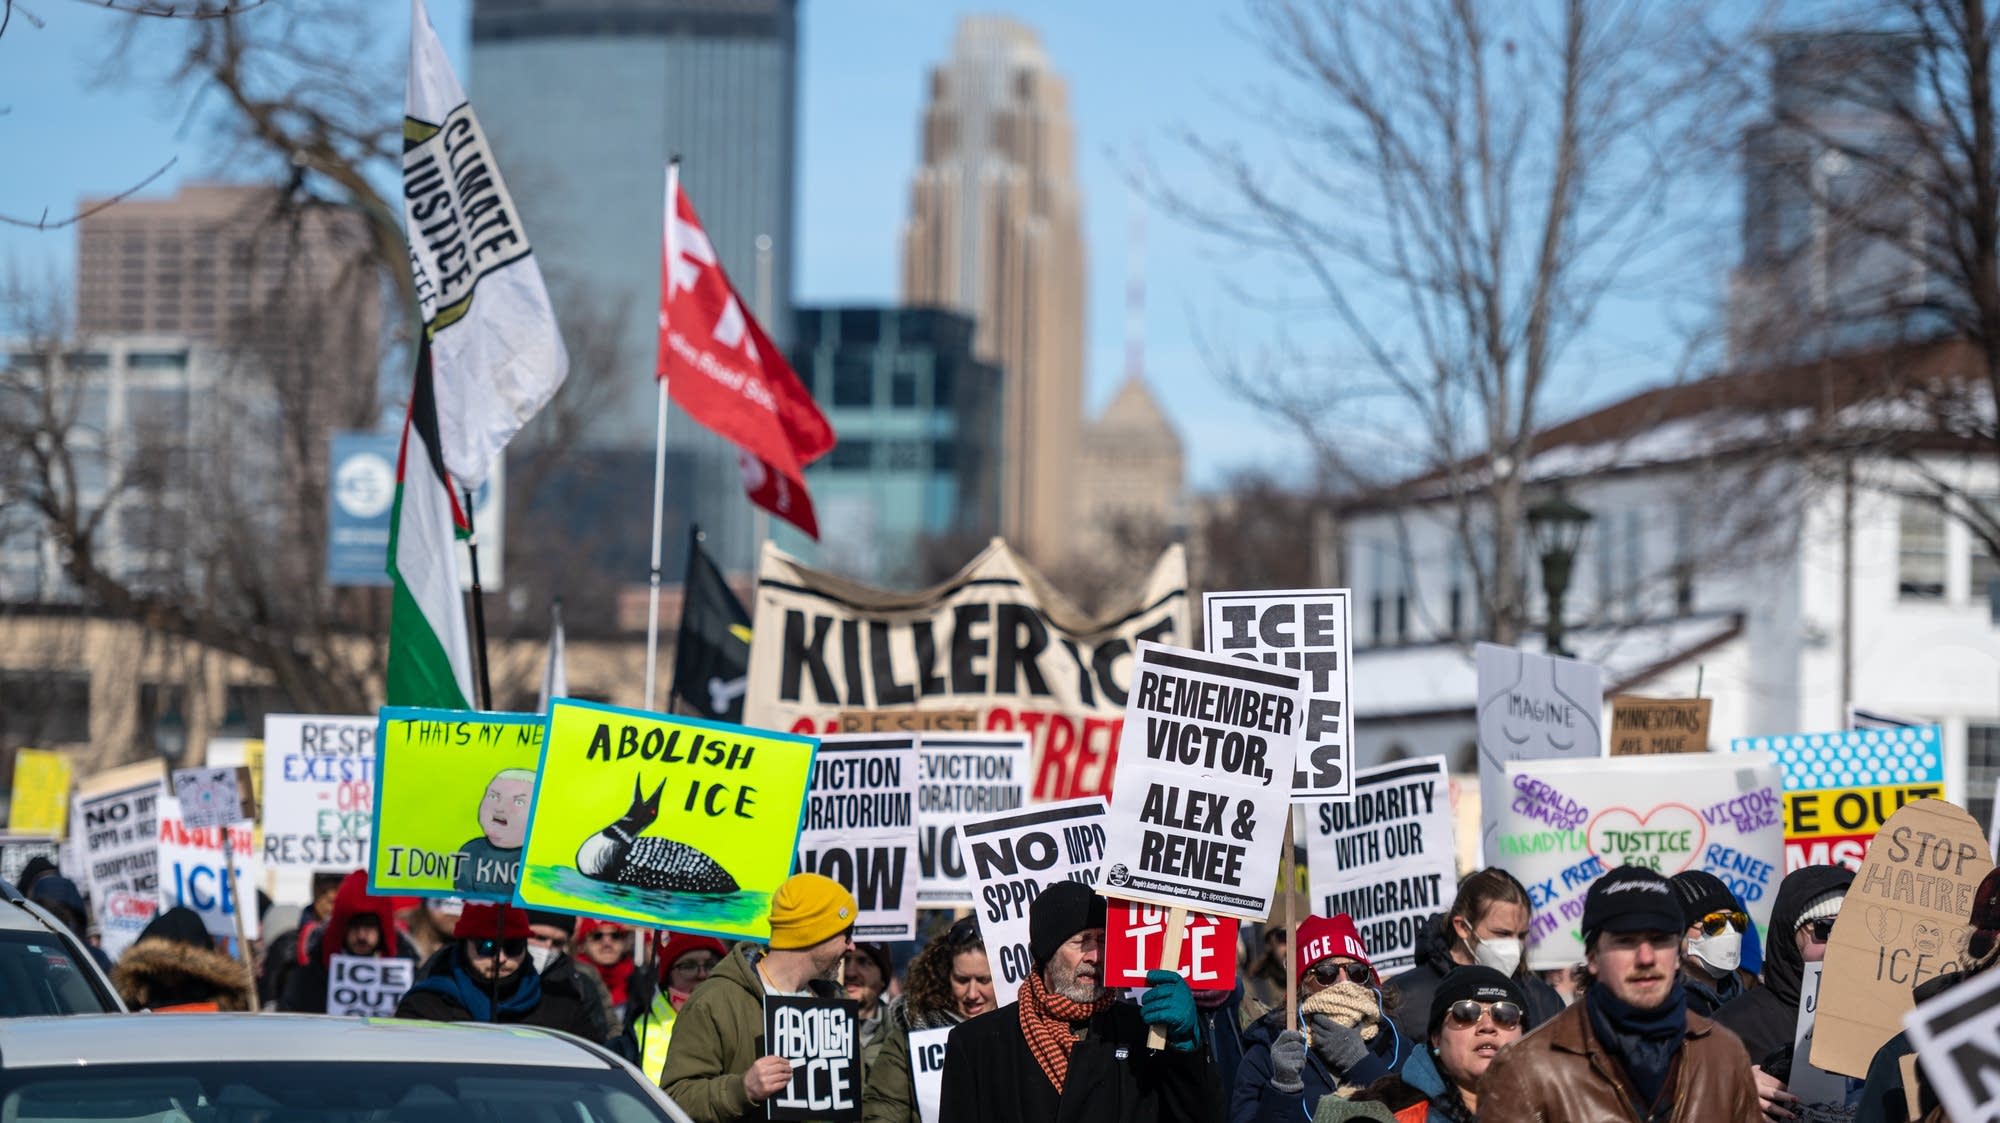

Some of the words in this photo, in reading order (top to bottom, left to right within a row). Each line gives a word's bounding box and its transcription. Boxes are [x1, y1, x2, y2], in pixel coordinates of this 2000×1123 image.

[444, 117, 519, 263] CLIMATE
[1222, 604, 1335, 650] ICE
[781, 603, 1051, 706] KILLER
[1137, 671, 1294, 735] REMEMBER
[1508, 694, 1576, 728] IMAGINE
[400, 719, 471, 746] THATS
[478, 723, 504, 747] MY
[586, 724, 755, 770] ABOLISH
[1147, 718, 1273, 786] VICTOR,
[85, 801, 130, 828] NO
[685, 781, 757, 819] ICE
[1140, 783, 1229, 836] ALEX
[1231, 799, 1256, 841] &
[1319, 781, 1435, 835] SOLIDARITY
[1512, 797, 1576, 831] CAMPOS
[1513, 774, 1588, 824] GERALDO
[1701, 787, 1779, 826] VICTOR
[387, 848, 403, 876] I
[408, 849, 470, 880] DONT
[972, 832, 1058, 880] NO
[1139, 830, 1245, 886] RENEE
[1335, 829, 1379, 871] WITH
[1385, 823, 1423, 859] OUR
[1601, 830, 1692, 853] JUSTICE
[1704, 842, 1775, 885] RENEE
[1887, 826, 1977, 876] STOP
[174, 861, 240, 916] ICE
[1325, 874, 1441, 922] IMMIGRANT
[1862, 863, 1976, 918] HATRE
[336, 963, 405, 986] ICE
[1303, 936, 1331, 966] ICE
[918, 1044, 946, 1073] IC
[776, 1058, 854, 1111] ICE
